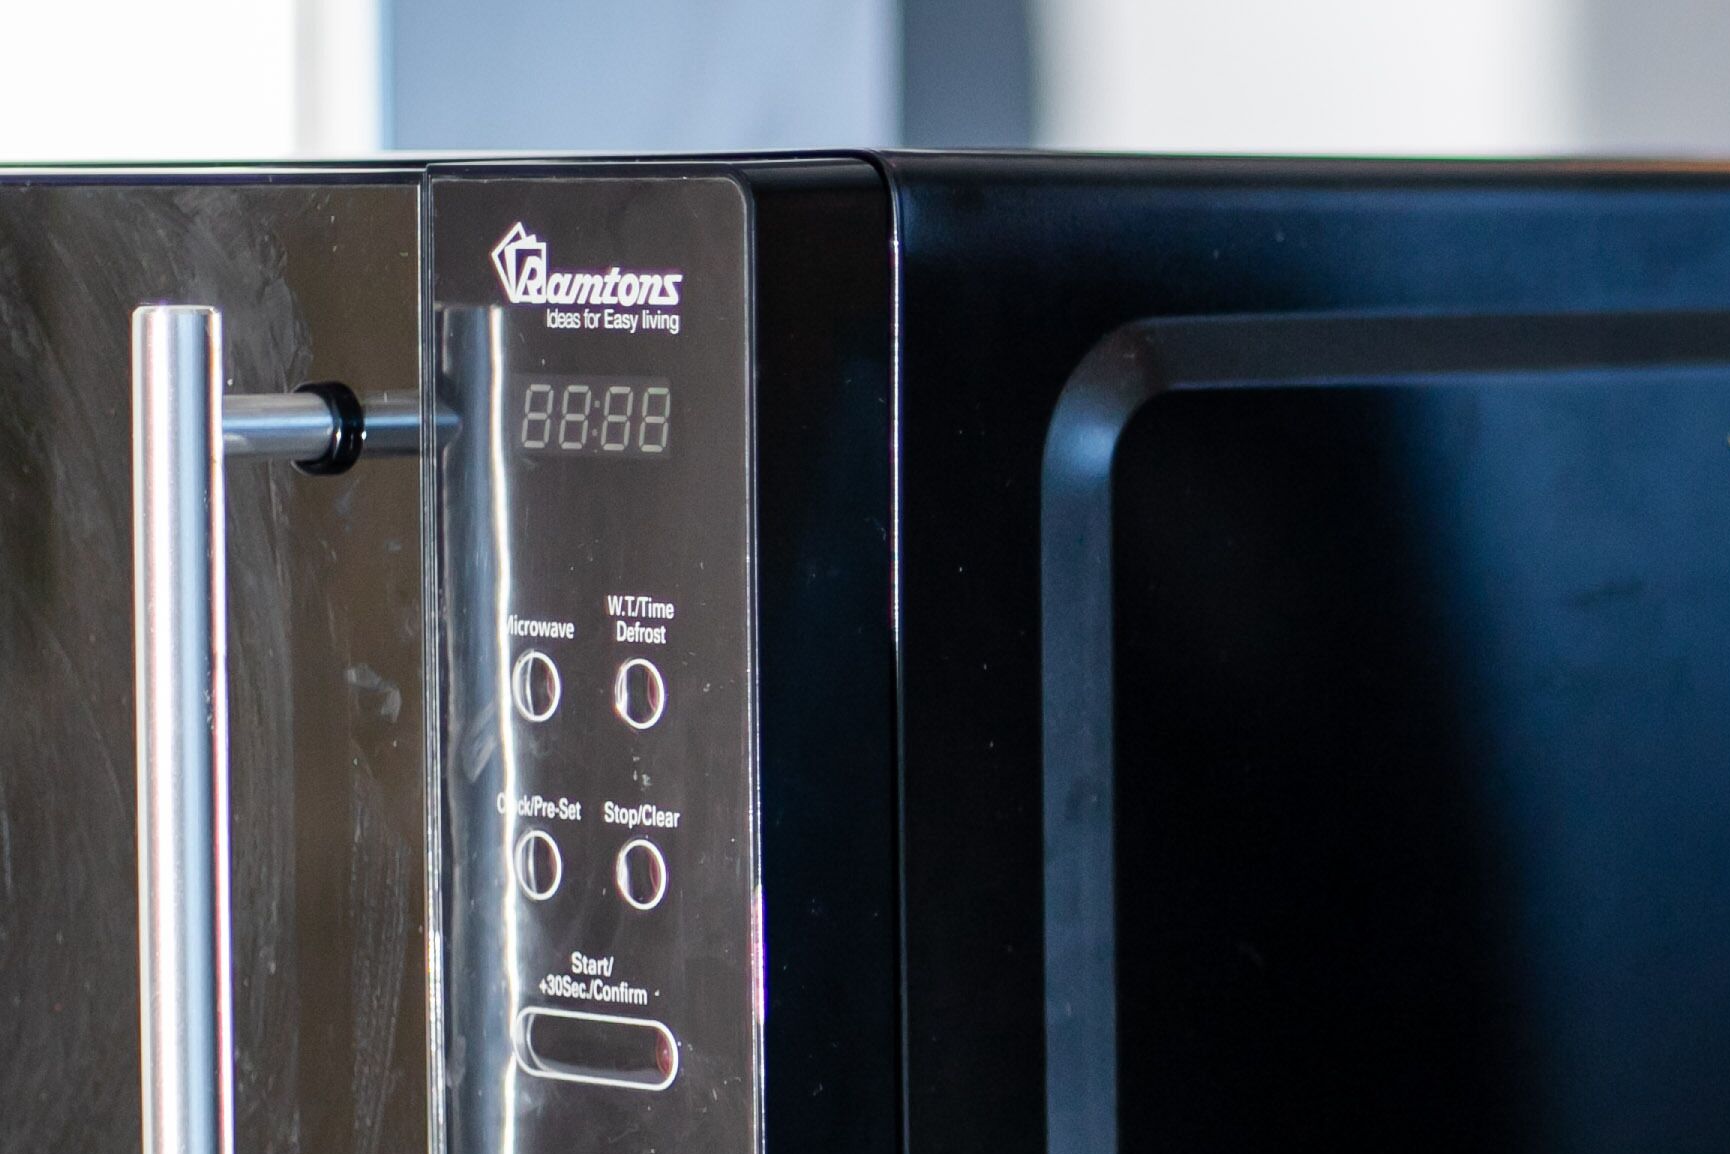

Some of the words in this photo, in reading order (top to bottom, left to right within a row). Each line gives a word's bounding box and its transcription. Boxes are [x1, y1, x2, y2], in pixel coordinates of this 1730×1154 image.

[516, 256, 683, 306] Ramtons
[546, 310, 581, 329] Ideas
[583, 310, 602, 329] for
[603, 310, 638, 334] Easy
[641, 310, 681, 334] living
[616, 621, 666, 645] Defrost
[497, 792, 582, 820] Cck/Pre-Set
[604, 800, 680, 829] Stop/Clear
[572, 950, 614, 977] Start/
[539, 976, 648, 1005] +30Sec./Confirm
